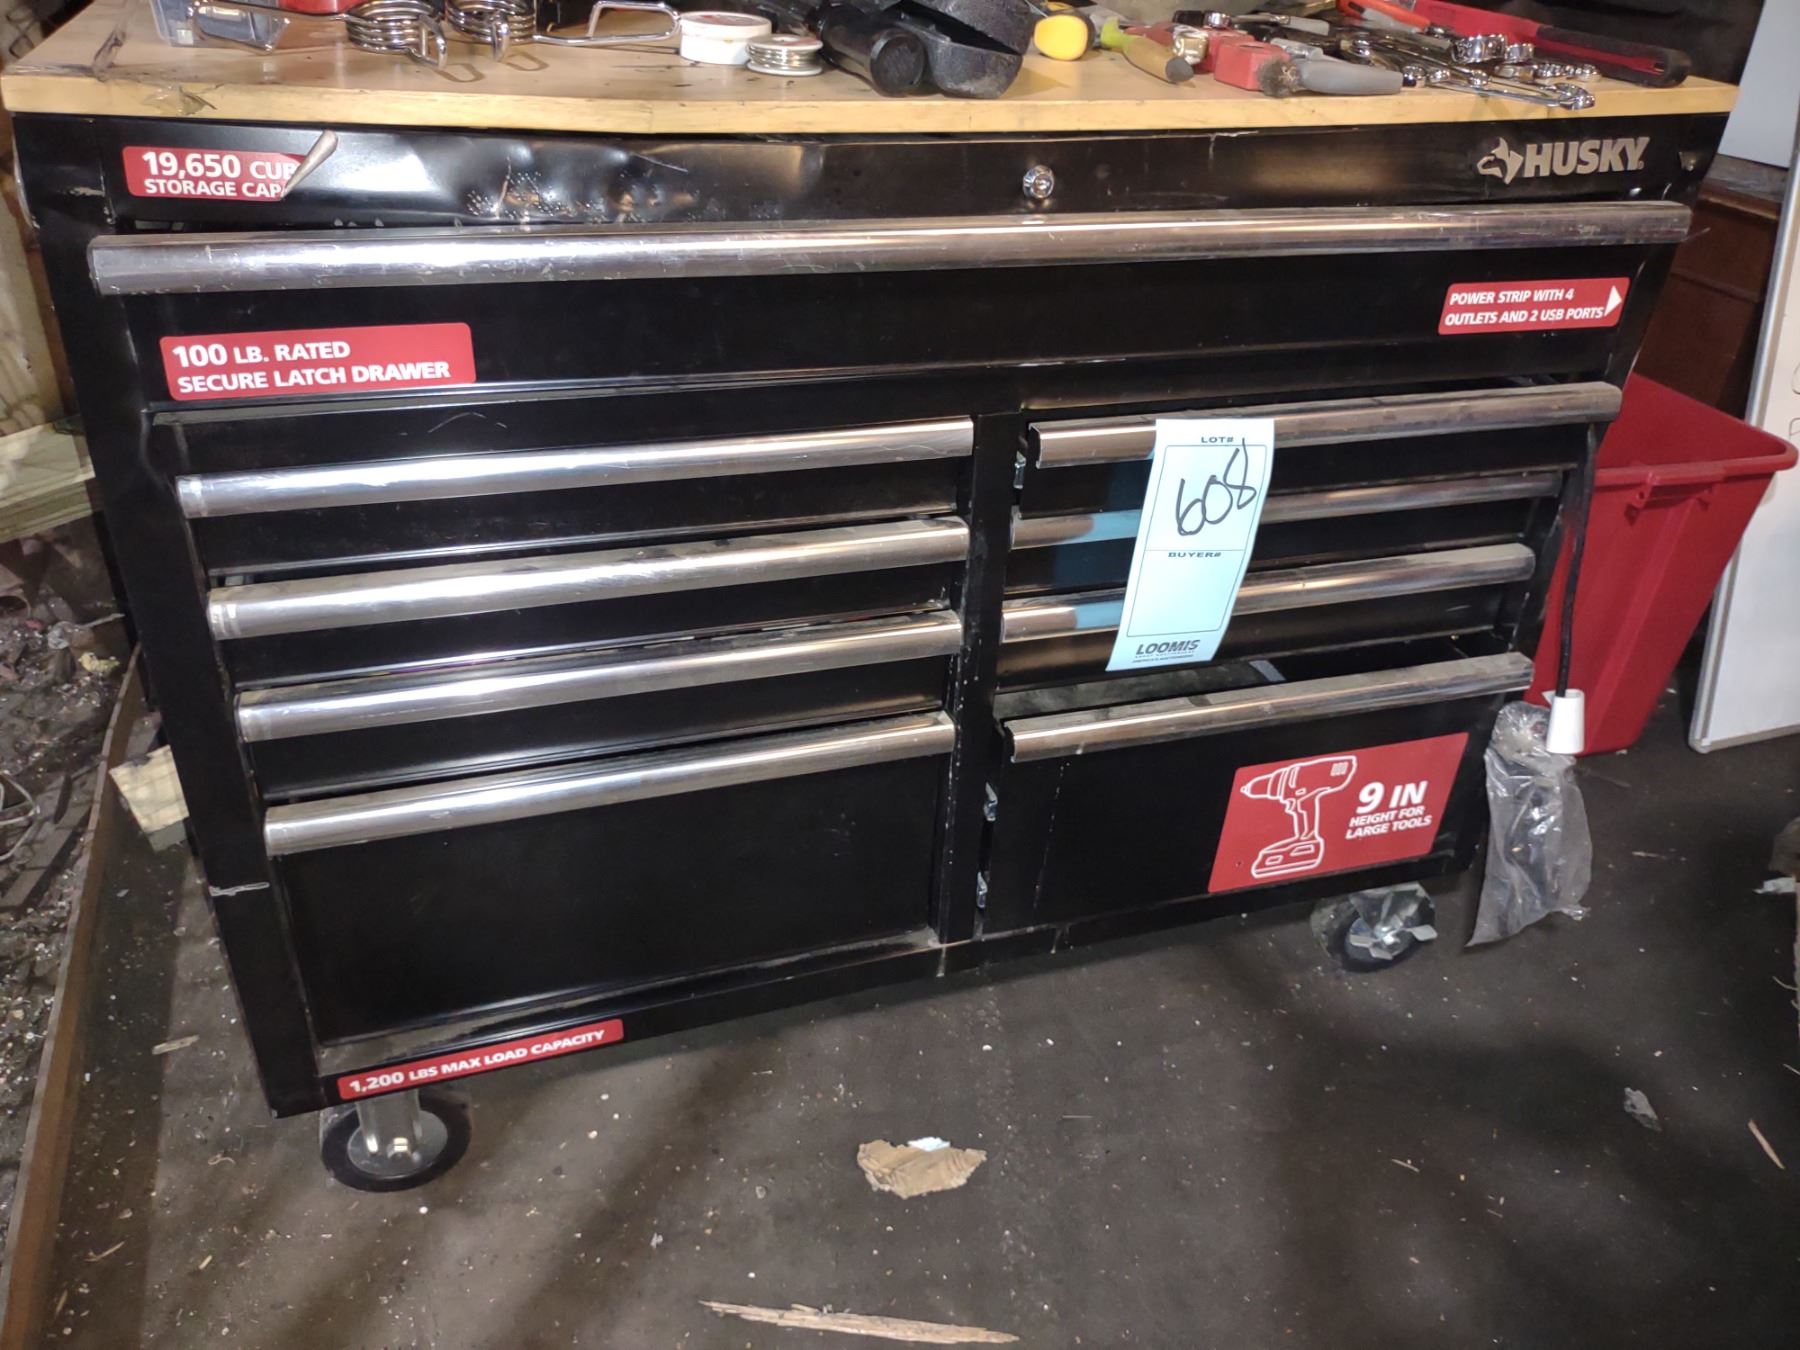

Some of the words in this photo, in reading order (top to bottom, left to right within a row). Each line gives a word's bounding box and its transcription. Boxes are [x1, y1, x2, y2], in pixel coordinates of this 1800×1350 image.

[142, 151, 241, 179] 19,650
[1523, 137, 1650, 178] HUSKY
[144, 179, 237, 196] STORAGE
[241, 182, 286, 198] CAP
[1449, 292, 1494, 306] POWER
[1497, 290, 1531, 304] STRIP
[1533, 288, 1564, 302] WITH
[1565, 288, 1575, 300] 4
[1444, 312, 1497, 326] OUTLETS
[1499, 310, 1528, 324] AND
[1529, 310, 1539, 322] 2
[1540, 308, 1563, 321] USB
[1565, 306, 1604, 320] PORTS
[172, 344, 228, 368] 100
[233, 346, 269, 364] LB.
[275, 341, 350, 361] RATED
[177, 370, 269, 393] SECURE
[273, 366, 347, 387] LATCH
[352, 361, 451, 383] DRAWER
[1200, 436, 1235, 444] LOT#
[1175, 437, 1257, 536] 608
[1167, 551, 1222, 559] BUYER#
[1135, 639, 1201, 655] LOOMIS
[1356, 781, 1385, 814] 9
[1388, 780, 1428, 809] IN
[1345, 823, 1390, 839] LARGE
[1391, 815, 1432, 831] TOOLS
[1349, 810, 1398, 828] HEIGHT
[1398, 805, 1425, 819] FOR
[348, 1072, 404, 1093] 1,200
[408, 1066, 439, 1081] LBS
[440, 1057, 482, 1075] MAX
[483, 1047, 529, 1065] LOAD
[530, 1029, 605, 1055] CAPACITY
